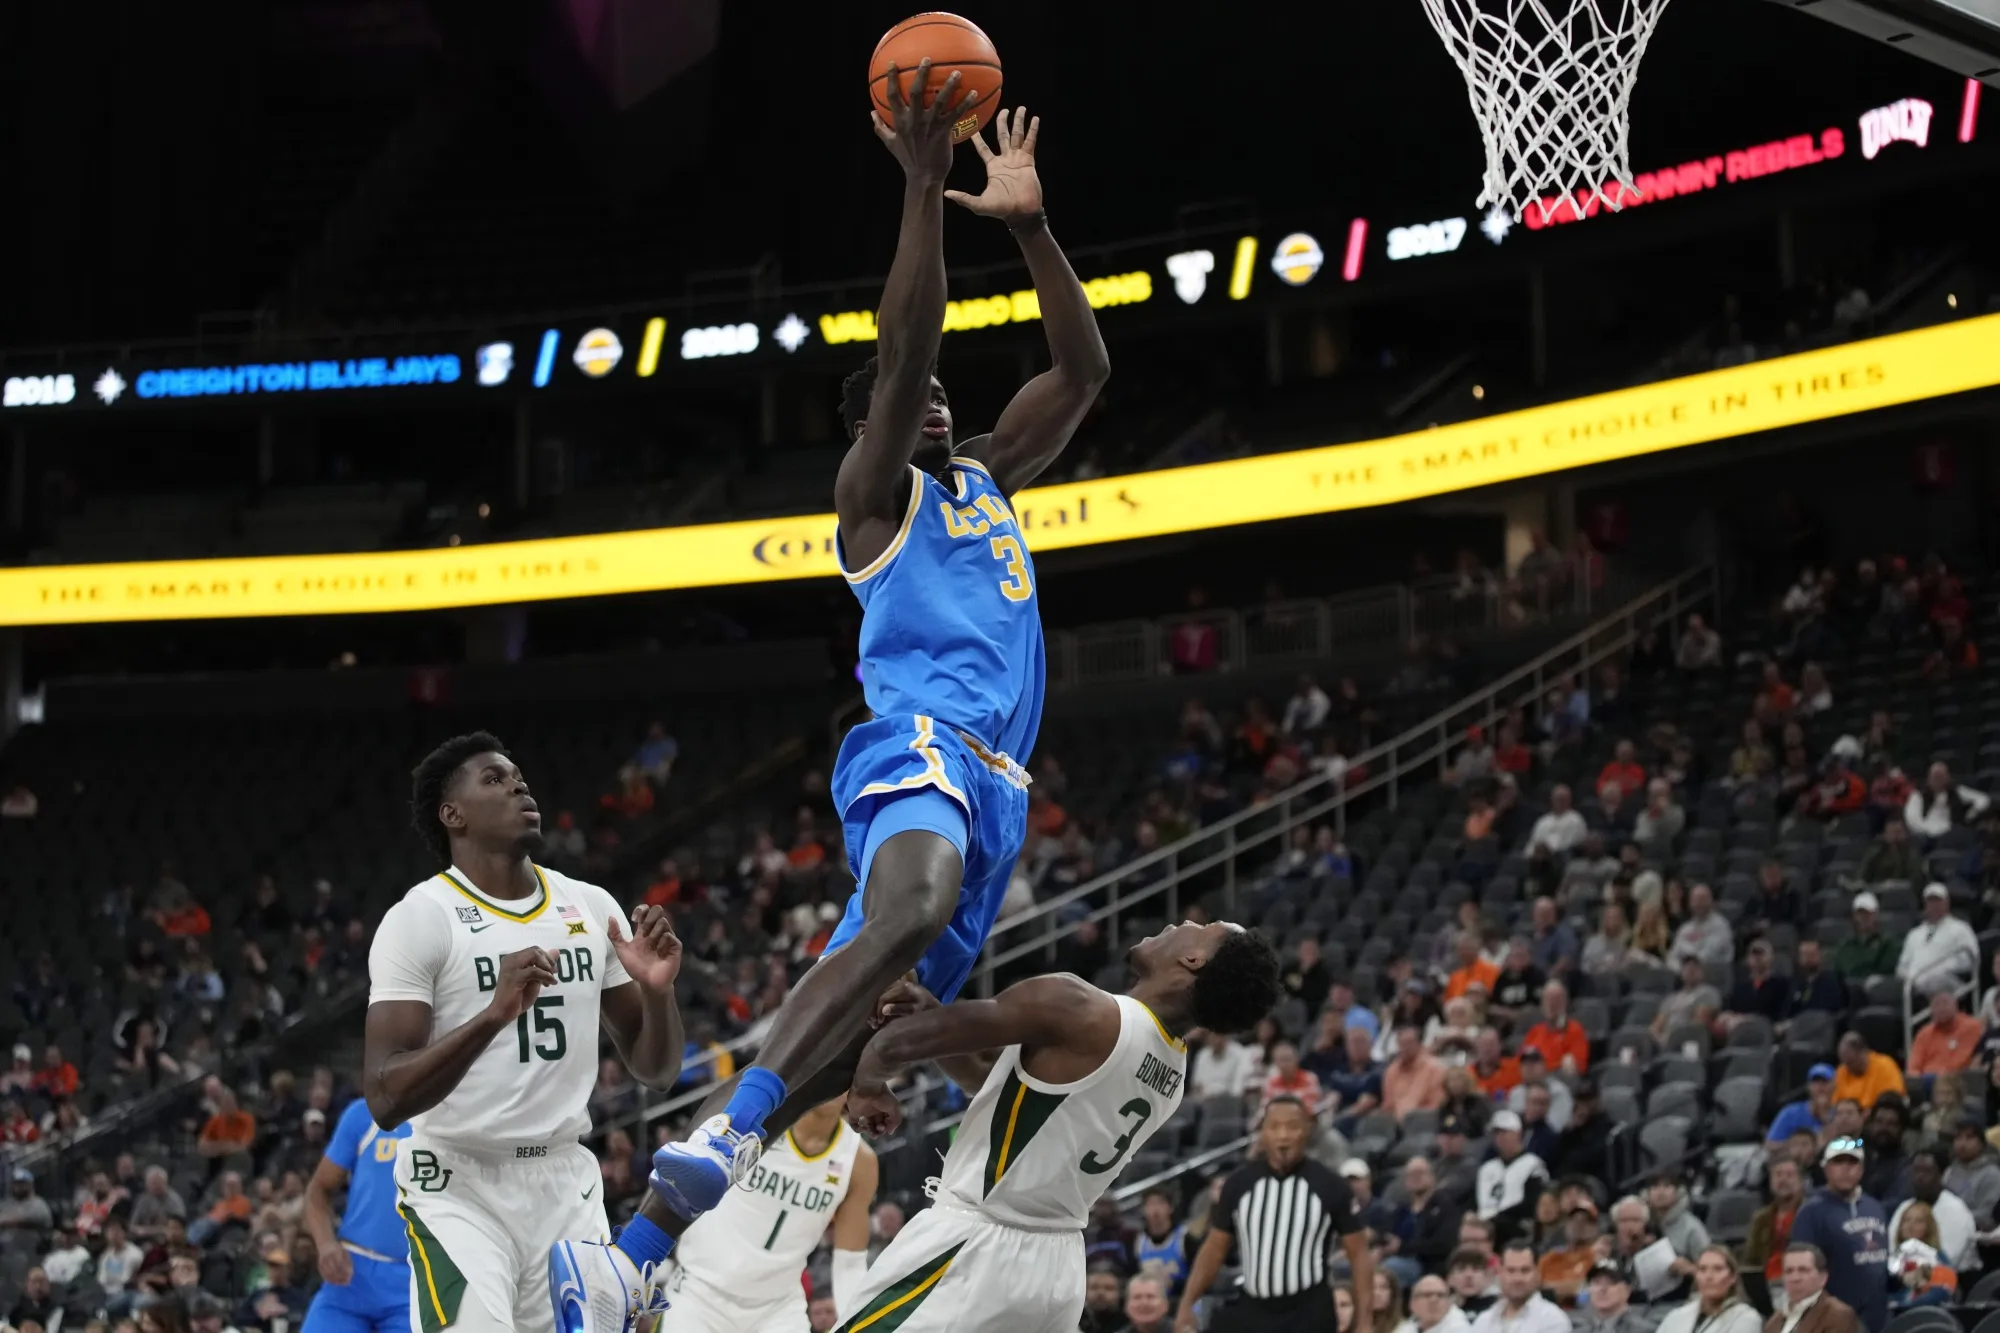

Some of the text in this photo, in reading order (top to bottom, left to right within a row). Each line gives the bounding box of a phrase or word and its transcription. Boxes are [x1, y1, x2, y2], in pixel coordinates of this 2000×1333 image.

[1725, 127, 1845, 183] REBELS
[136, 363, 305, 398] CREIGHTON
[308, 354, 460, 389] BLUEJAYS
[1309, 363, 1886, 489] THE SMART CHOICE IN TIRES
[38, 557, 601, 604] THE SMART CHOICE IN TIRES
[990, 534, 1033, 602] 3
[517, 996, 567, 1063] 15
[1135, 1051, 1183, 1100] BONNER
[516, 1146, 547, 1158] BEARS
[1080, 1097, 1152, 1175] 3
[748, 1163, 834, 1213] BAYLOR
[765, 1210, 788, 1251] 1
